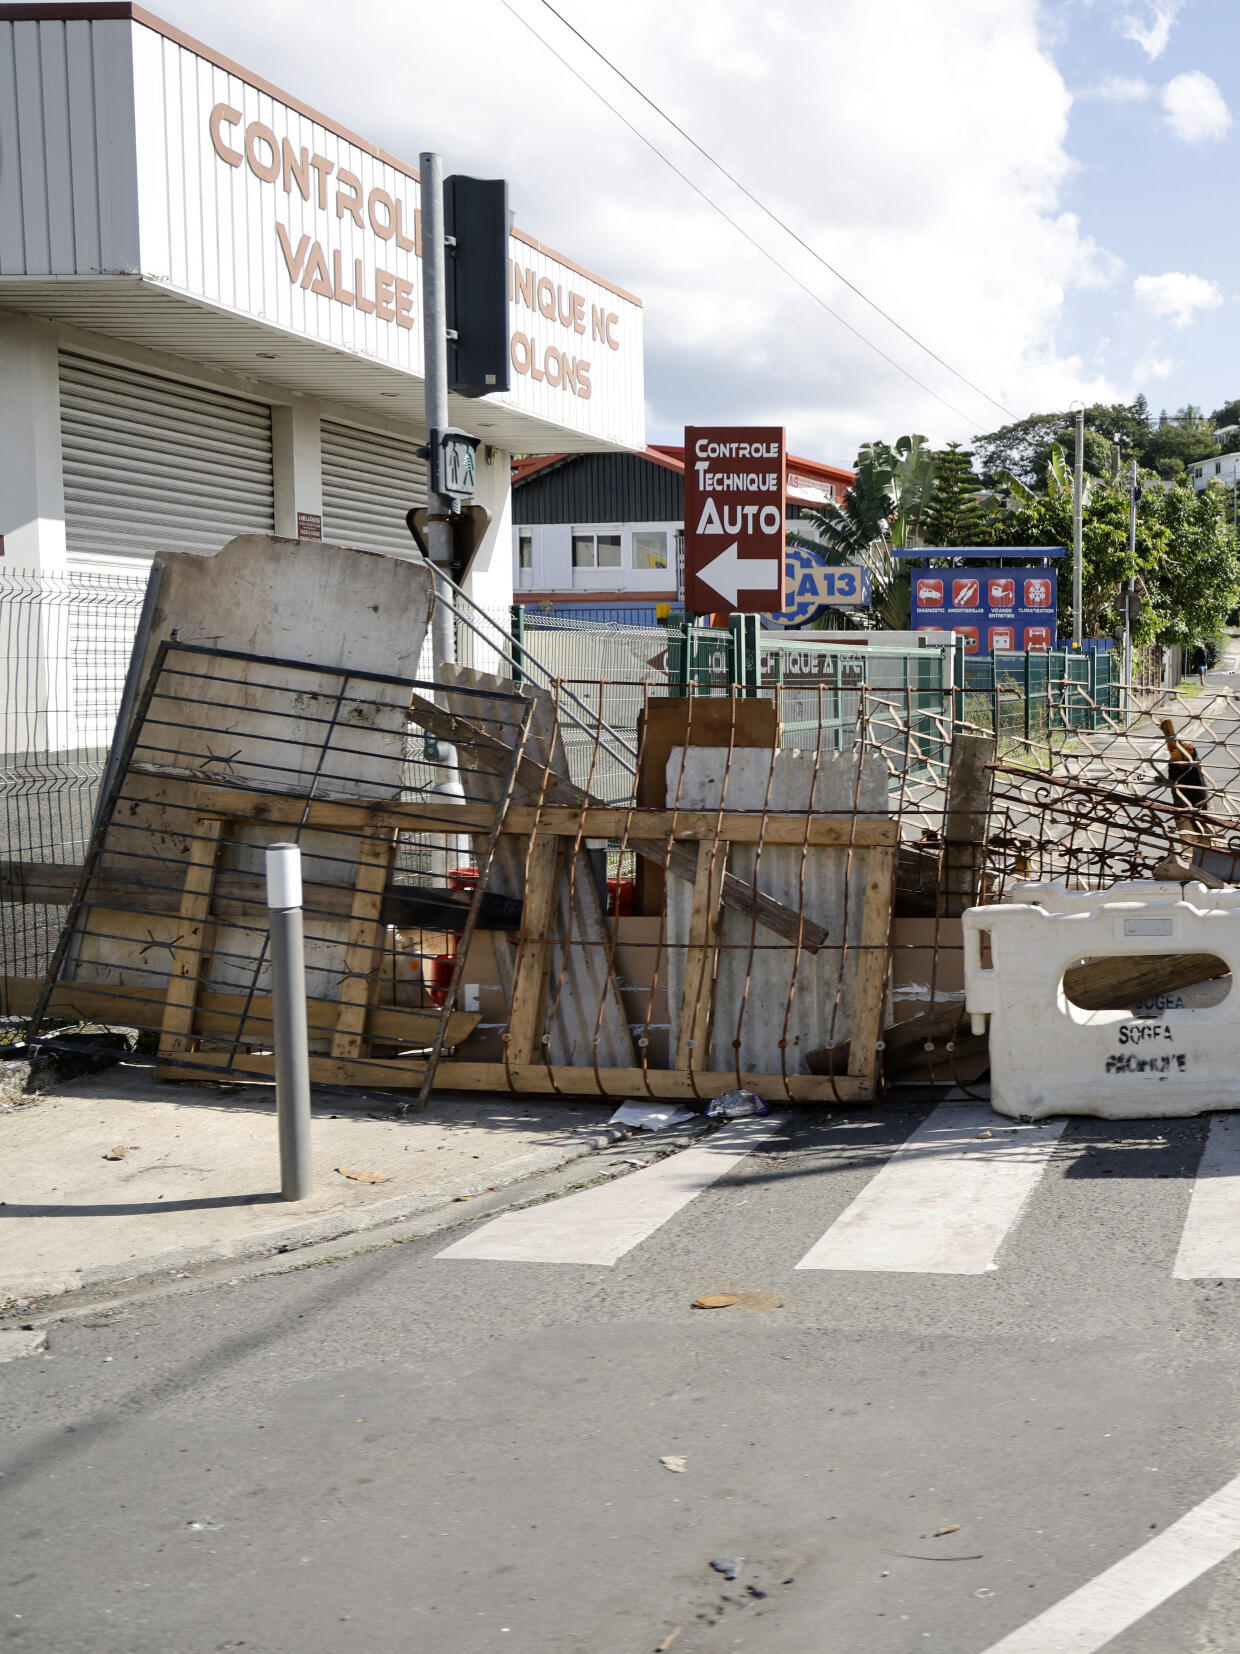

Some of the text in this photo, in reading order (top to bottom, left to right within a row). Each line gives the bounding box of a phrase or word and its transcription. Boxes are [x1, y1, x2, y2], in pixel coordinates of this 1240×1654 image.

[275, 221, 592, 400] VALLEE OLONS
[509, 258, 586, 335] NIQUE
[592, 303, 620, 351] NC
[695, 439, 779, 458] CONTROLE
[694, 461, 778, 491] TECHNIQUE
[696, 497, 780, 534] AUTO
[824, 573, 857, 596] 13
